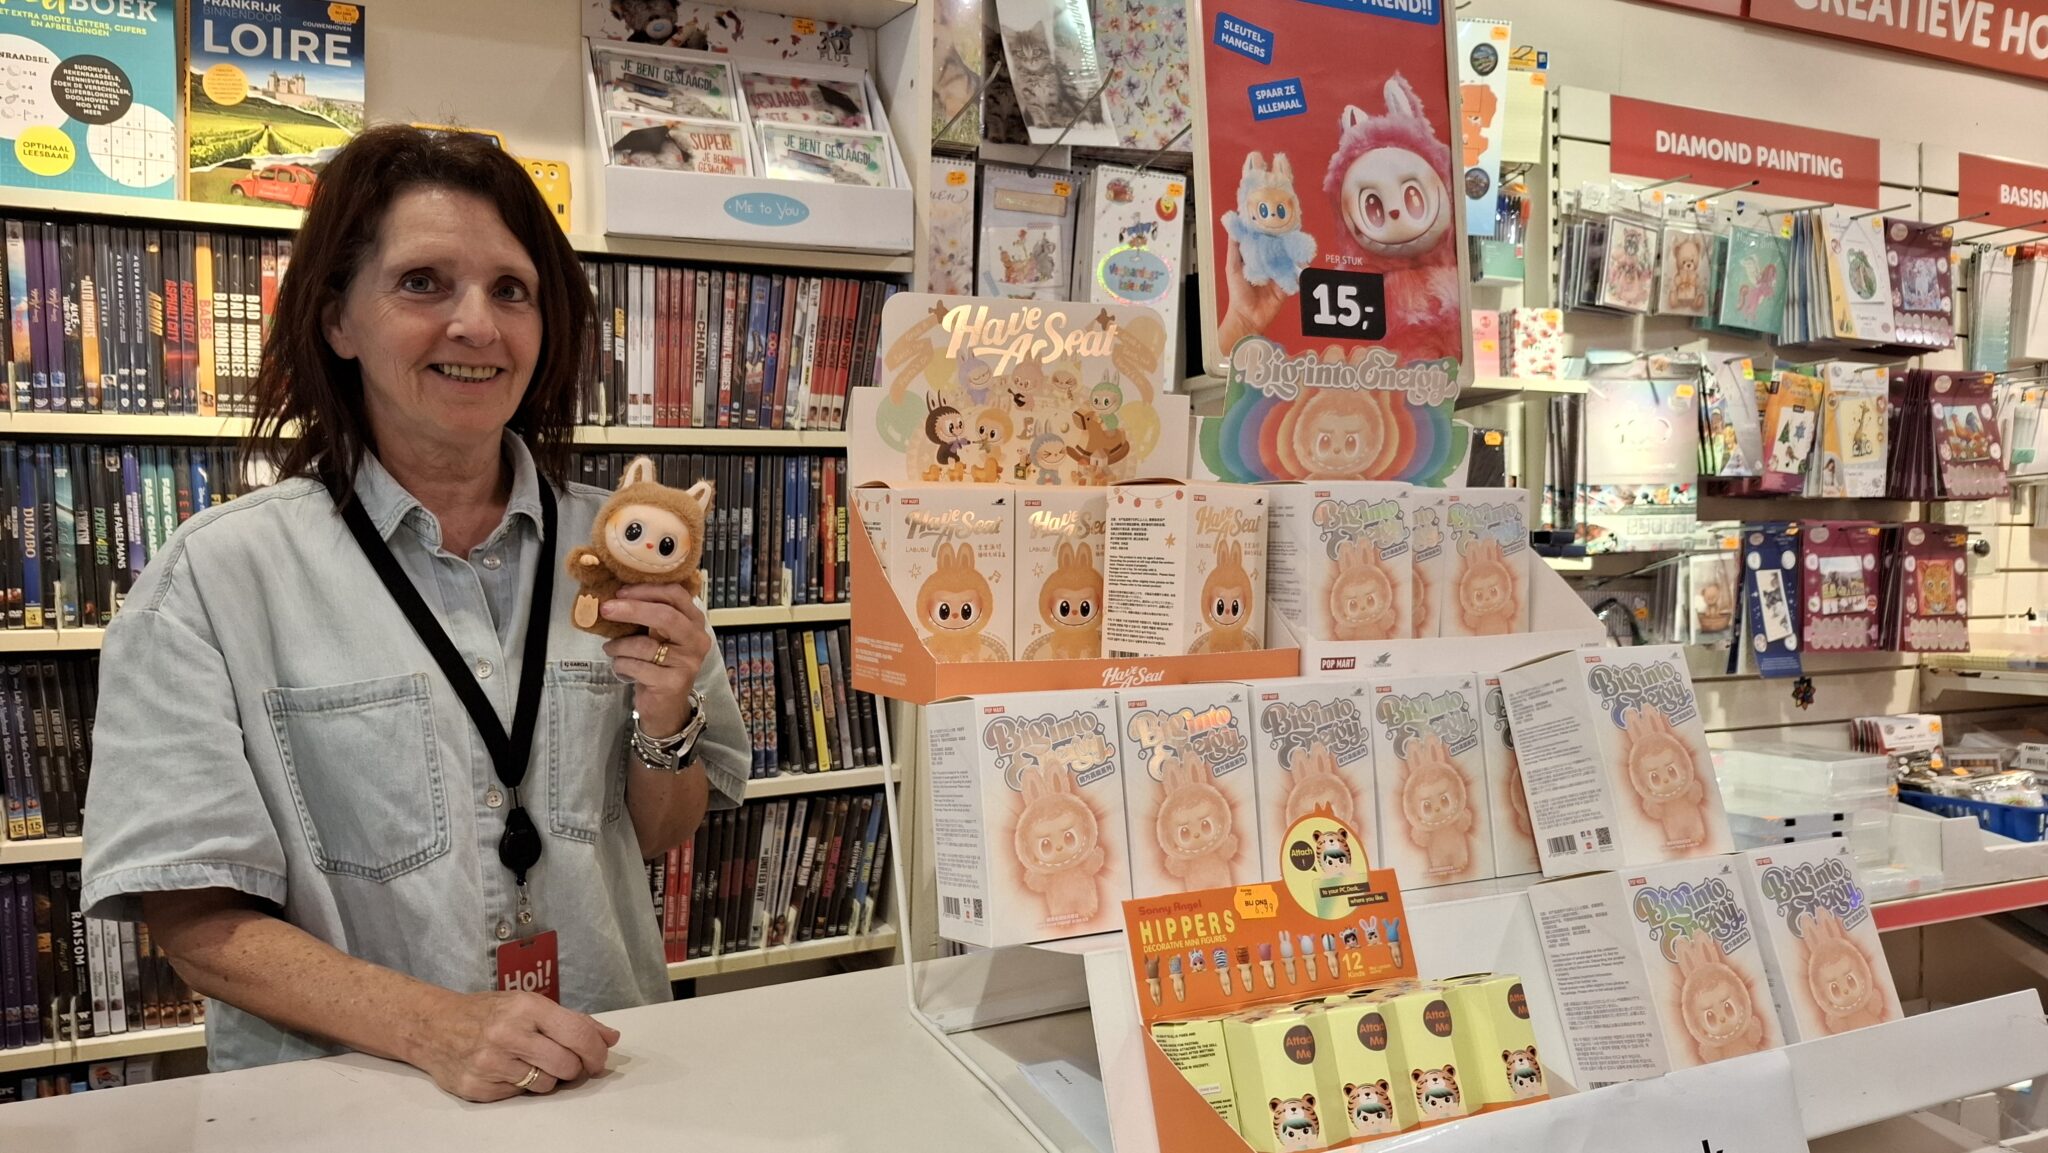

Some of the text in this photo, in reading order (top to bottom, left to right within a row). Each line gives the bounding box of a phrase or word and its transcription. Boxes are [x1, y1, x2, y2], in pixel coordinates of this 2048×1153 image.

[11, 10, 147, 35] EXTRA GROTE LETTERS, CIJFERS
[45, 22, 109, 36] AFBEELDINGEN
[203, 6, 281, 22] BINNENDOOR
[204, 19, 352, 67] LOIRE
[1221, 33, 1265, 58] HANGERS
[1223, 20, 1265, 44] SLEUTEL-
[63, 69, 121, 82] REKENRAADSELS,
[66, 76, 120, 88] KENNISVRAGEN,
[621, 59, 713, 90] JE BENT GESLAAGD!
[65, 94, 108, 104] DOOLHOVEN
[84, 84, 131, 96] VERSCHILLEN,
[752, 90, 808, 109] GESLAAGD!
[1255, 85, 1296, 100] SPAAR ZE
[1258, 99, 1302, 115] ALLEMAAL
[23, 142, 70, 152] OPTIMAAL
[23, 150, 69, 160] LEESBAAR
[690, 132, 732, 151] SUPER!
[784, 135, 871, 165] JE BENT GESLAAGD!
[1656, 130, 1844, 179] DIAMOND PAINTING
[760, 201, 799, 221] to You
[1325, 254, 1363, 266] PER STUK
[81, 279, 96, 338] ALTO KNIGHTS
[149, 291, 162, 336] ARMOR
[166, 279, 179, 343] ASPHALT CITY
[182, 280, 195, 343] ASPHALT CITY
[199, 299, 211, 339] BABES
[1312, 283, 1374, 330] 15,-
[214, 292, 229, 377] BAD HOMBRES
[230, 294, 244, 377] BAD HOMBRES
[247, 295, 260, 377] BAD HOMBRES
[721, 308, 734, 390] CHERNOBYL DIARIES
[840, 318, 853, 370] DEAD SHOT
[942, 304, 1041, 358] Have
[1034, 312, 1118, 364] Seat
[695, 321, 706, 387] CHANNEL
[1233, 339, 1460, 406] Big into Energy
[143, 479, 153, 512] FAST
[161, 479, 172, 512] FAST
[23, 507, 36, 558] DUMBO
[95, 507, 108, 565] EXPEND4BLES
[905, 509, 1004, 539] Have Seat
[1028, 510, 1079, 539] Have
[1196, 505, 1233, 535] Have
[1230, 509, 1261, 537] Seat
[115, 517, 126, 569] FABELMANS
[1102, 666, 1165, 686] Have Seat
[1322, 659, 1335, 669] POP
[1336, 658, 1355, 669] MART
[1262, 698, 1354, 739] Big into
[983, 716, 1051, 757] Big
[12, 824, 24, 833] 15
[29, 822, 41, 831] 15
[1291, 847, 1313, 857] Attach
[654, 864, 664, 906] TRIPLE
[758, 857, 768, 883] UNITED
[1762, 858, 1845, 905] Big into
[757, 886, 766, 902] WAY
[1138, 899, 1202, 916] Sonny Angel
[1633, 877, 1727, 928] Big into
[71, 912, 85, 965] RANSOM
[1139, 909, 1235, 945] HIPPERS
[1144, 934, 1227, 953] DECORATIVE MINI FIGURES
[504, 960, 551, 991] Hoi!
[1342, 952, 1363, 971] 12
[1369, 1036, 1385, 1046] Me
[1435, 1023, 1450, 1032] Me
[1296, 1049, 1312, 1059] Me
